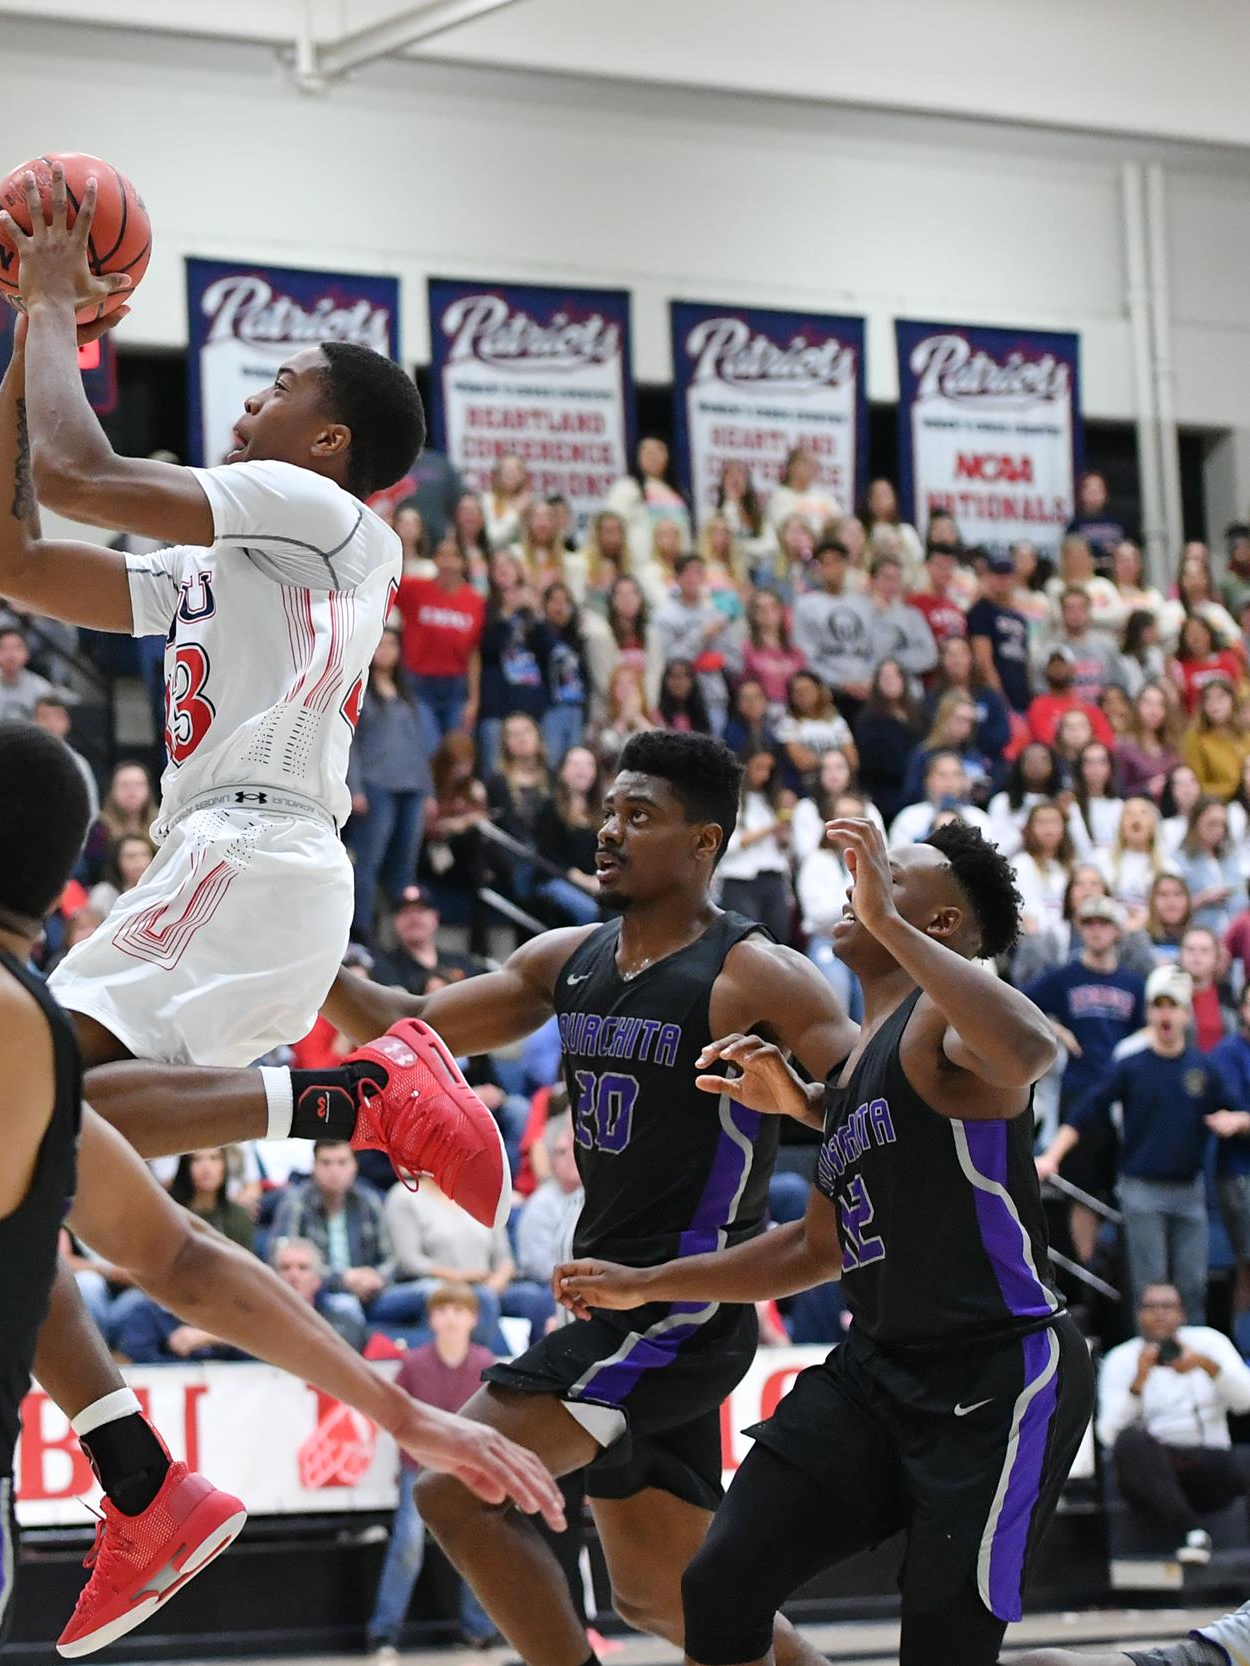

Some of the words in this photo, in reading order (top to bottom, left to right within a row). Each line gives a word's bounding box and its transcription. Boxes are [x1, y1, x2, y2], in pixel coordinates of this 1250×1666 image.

[202, 275, 390, 349] Patriots
[441, 294, 622, 365] Patriots
[686, 317, 855, 386] Patriots
[910, 334, 1069, 399] Patriots
[461, 435, 614, 466] CONFERENCE
[465, 404, 607, 434] HEARTLAND
[461, 467, 614, 496] CHPIONS
[956, 453, 1033, 483] NCAA
[928, 492, 1071, 525] NATIONALS
[165, 642, 217, 769] 3
[575, 1069, 640, 1155] 20
